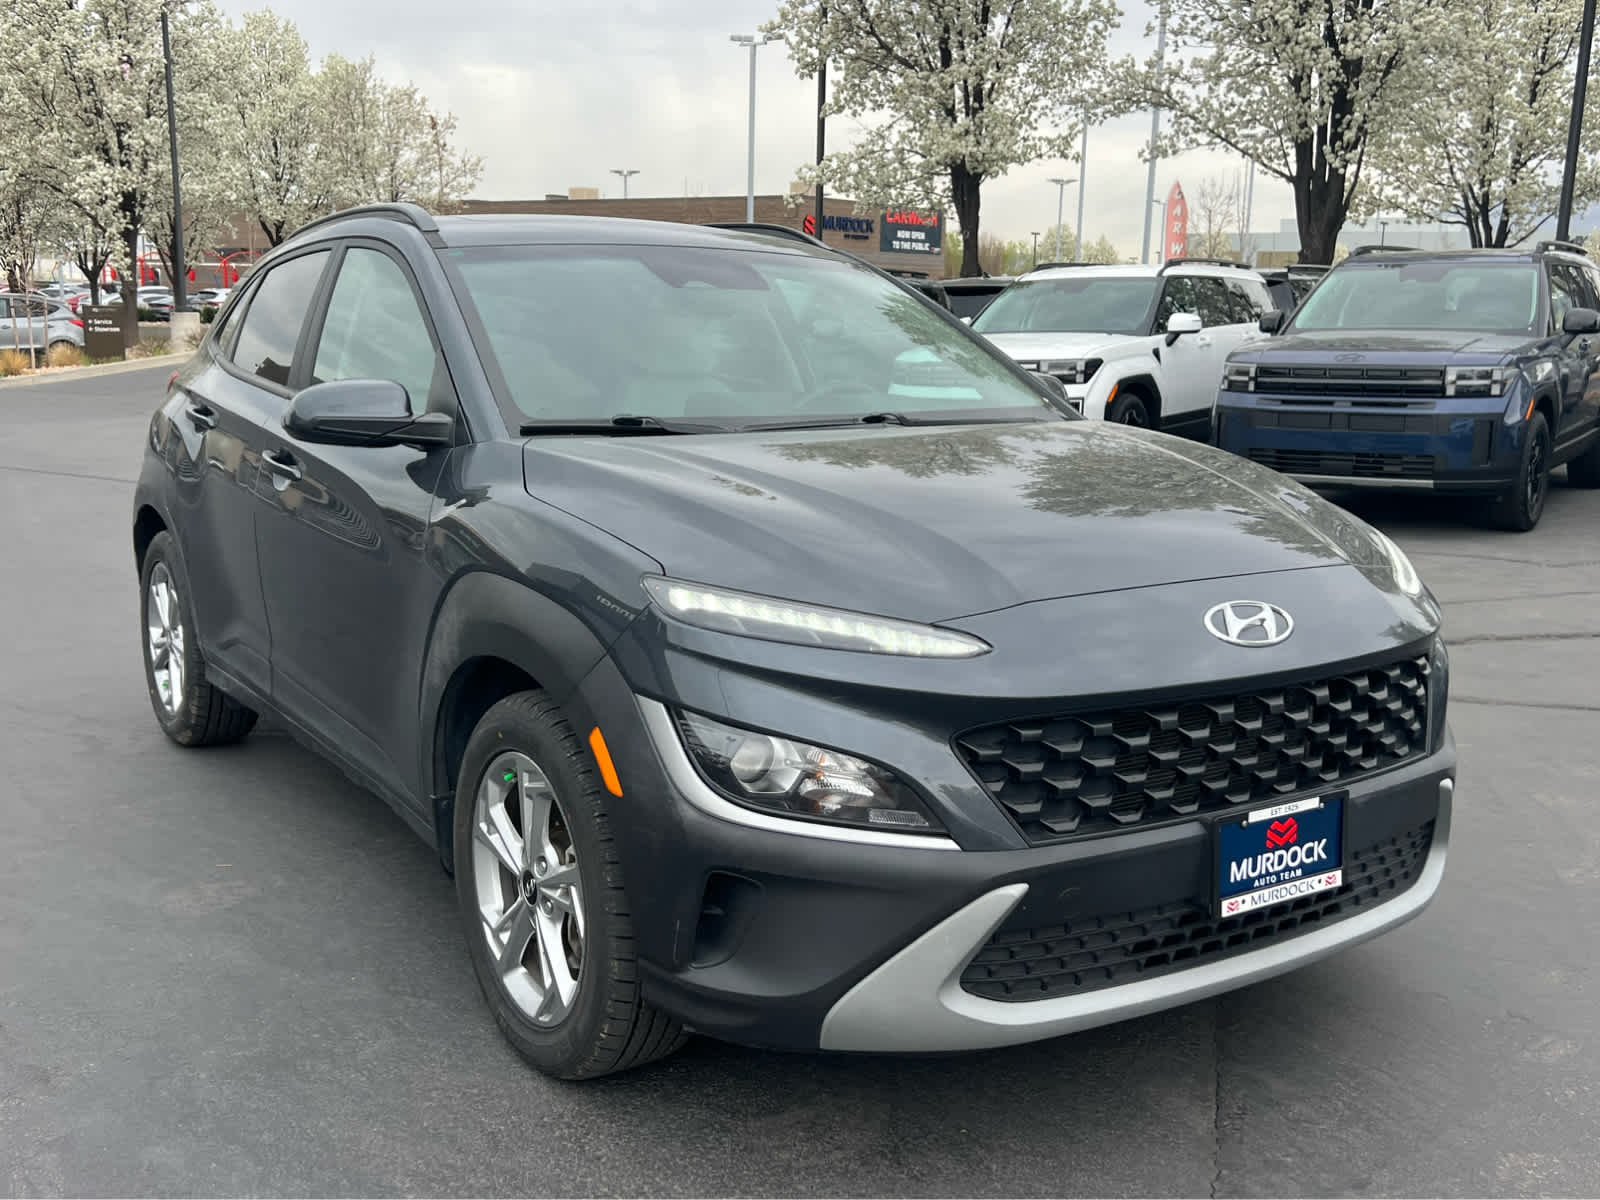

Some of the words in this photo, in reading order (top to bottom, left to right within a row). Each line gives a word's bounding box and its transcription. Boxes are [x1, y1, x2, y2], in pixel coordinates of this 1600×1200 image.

[822, 215, 874, 233] MURDOCK
[897, 230, 910, 239] NOW
[911, 231, 925, 240] OPEN
[892, 240, 900, 249] TO
[901, 241, 911, 250] THE
[912, 242, 930, 251] PUBLIC
[1230, 838, 1327, 883] MURDOCK
[1253, 875, 1277, 887] AUTO
[1280, 868, 1302, 880] TEAM
[1250, 879, 1315, 906] MURDOCK
